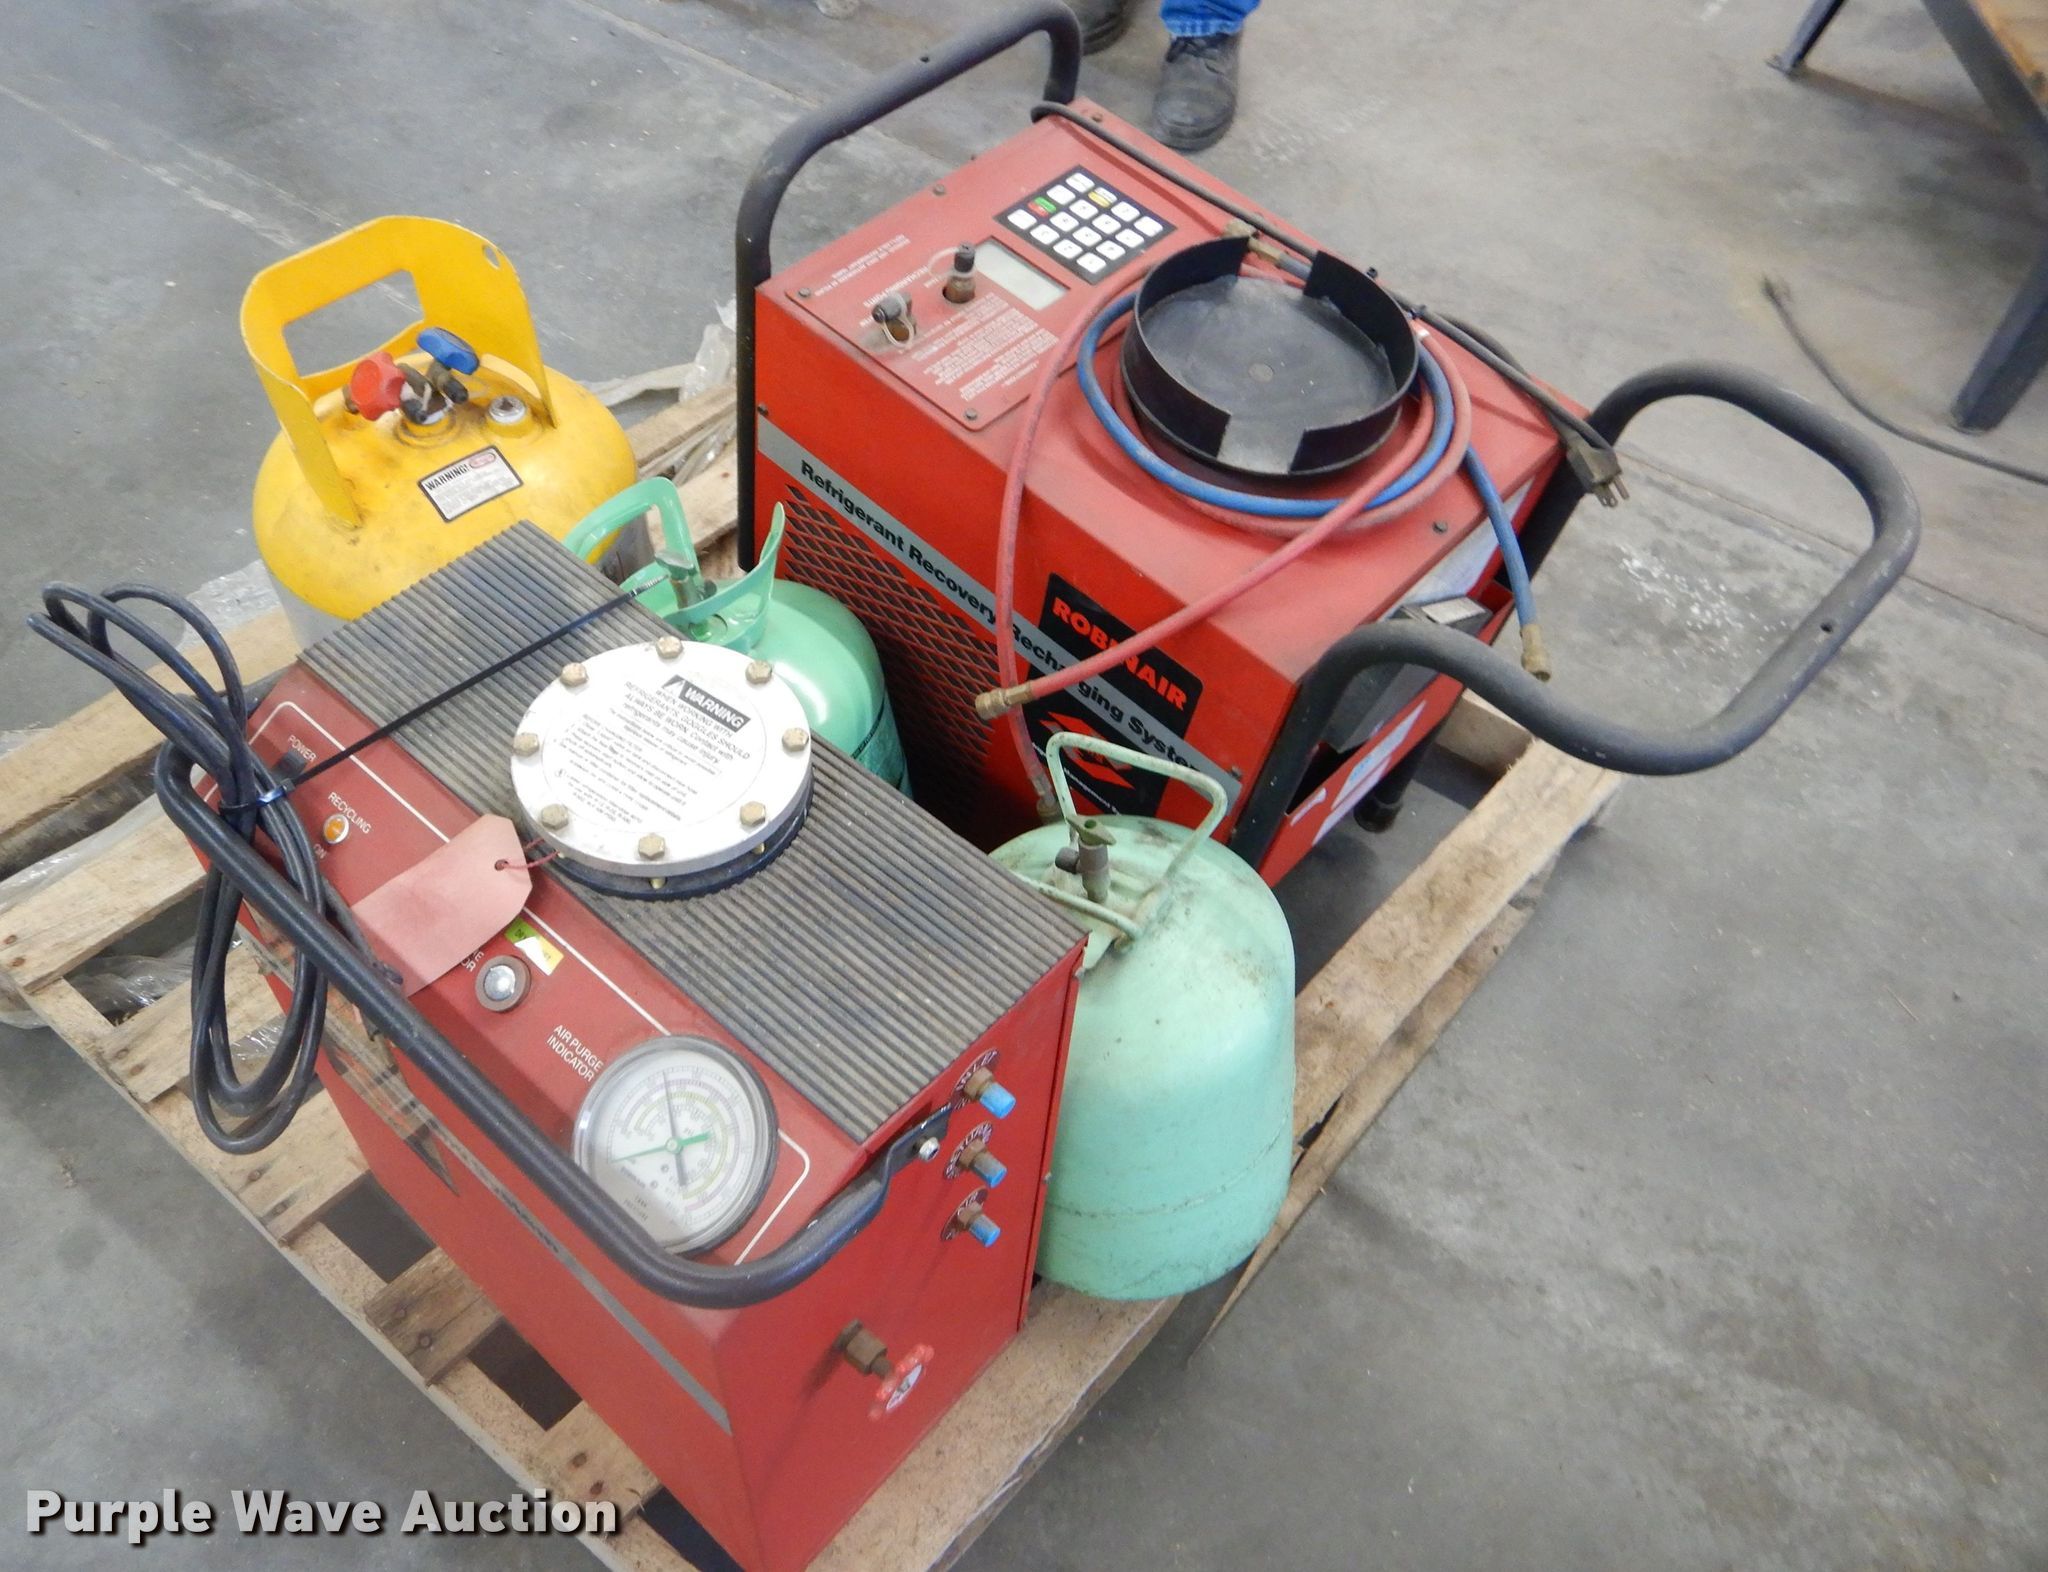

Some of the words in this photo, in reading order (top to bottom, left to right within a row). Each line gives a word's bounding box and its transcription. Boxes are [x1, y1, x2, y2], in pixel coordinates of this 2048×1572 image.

[424, 463, 470, 491] WARNING!
[801, 459, 904, 551] Refrigerant
[908, 544, 996, 625] Recovery
[1012, 624, 1124, 723] Rechging
[1128, 716, 1199, 770] Syste
[676, 702, 712, 726] WORKING
[712, 723, 732, 739] WITH
[684, 687, 745, 729] WARNING
[288, 734, 317, 762] POWER
[717, 736, 750, 760] SHOULD
[328, 791, 372, 834] RECYCLING
[313, 843, 327, 859] ON
[546, 1035, 595, 1082] INDICATOR
[553, 1024, 573, 1041] AIR
[568, 1039, 604, 1072] PURGE
